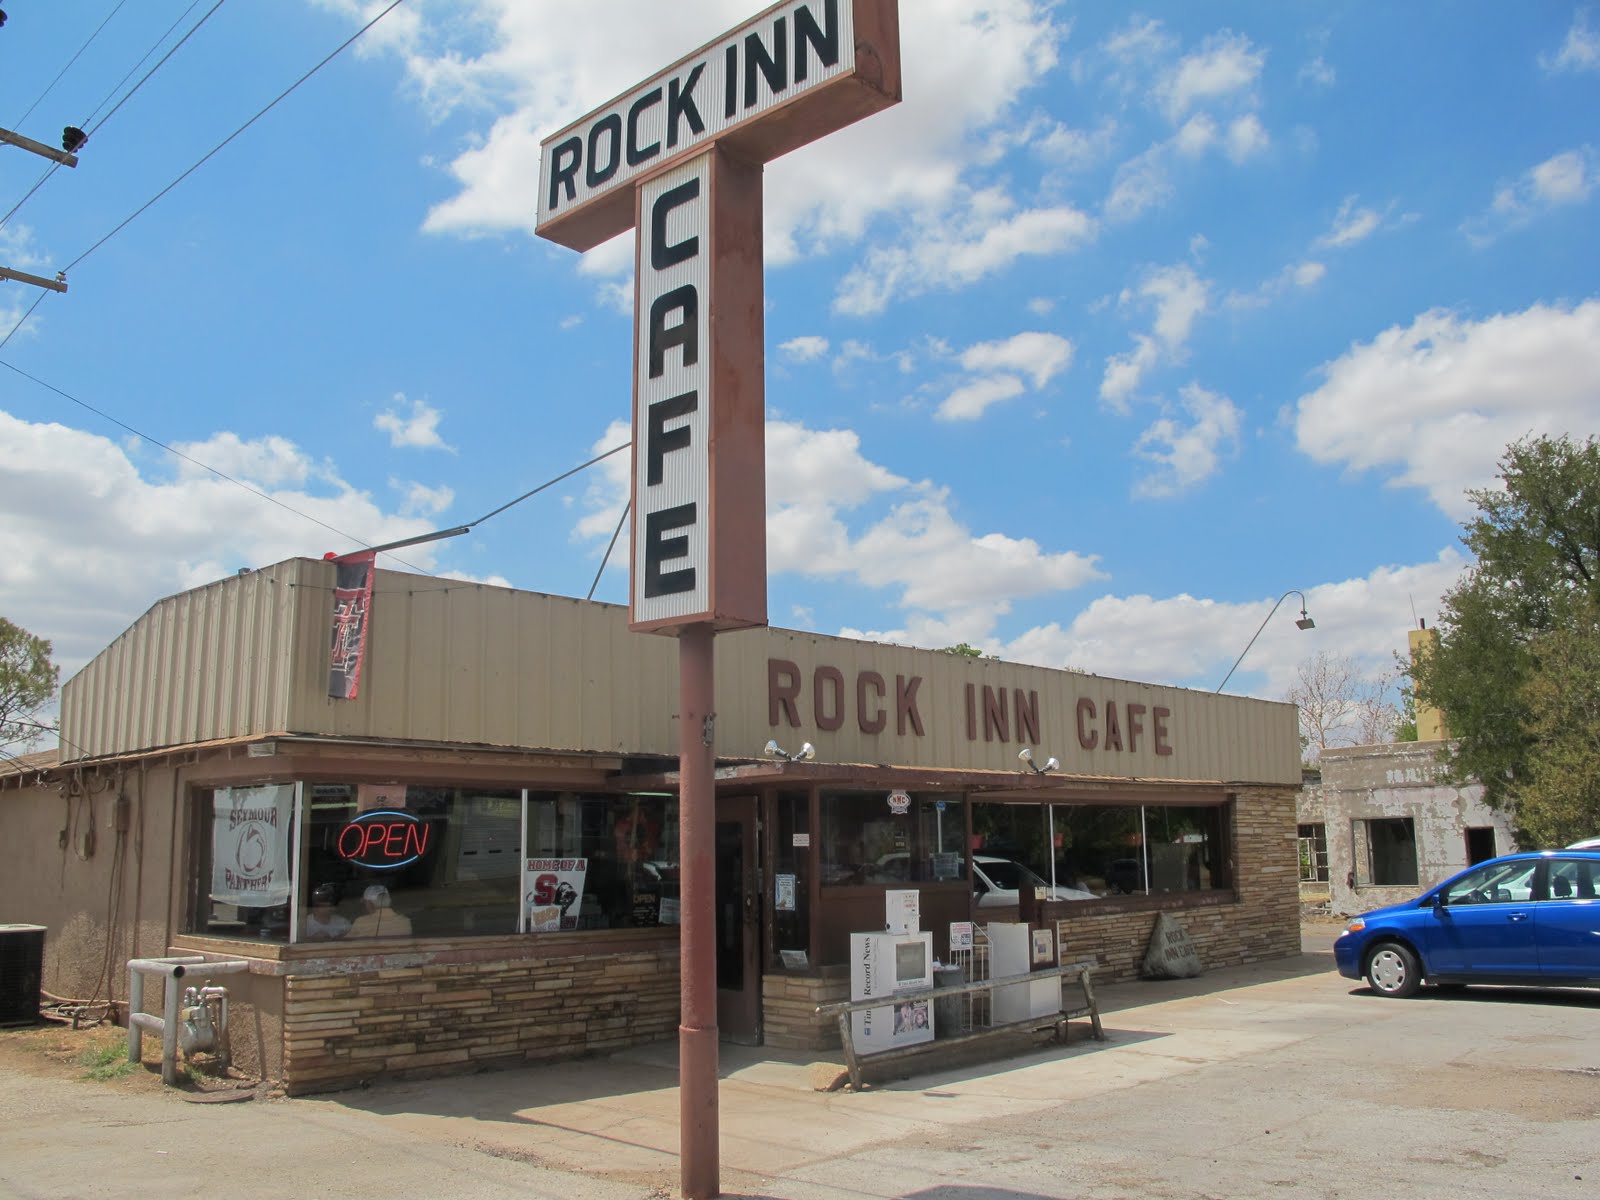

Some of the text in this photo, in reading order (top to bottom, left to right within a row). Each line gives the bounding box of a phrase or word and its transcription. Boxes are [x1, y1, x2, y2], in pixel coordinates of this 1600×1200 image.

[549, 0, 839, 210] ROCK INN
[644, 176, 700, 599] CAFE
[767, 657, 1173, 756] ROCK INN CAFE
[229, 807, 278, 832] SEYMOUR
[338, 823, 429, 858] OPEN
[533, 874, 559, 906] S
[863, 963, 871, 996] Record
